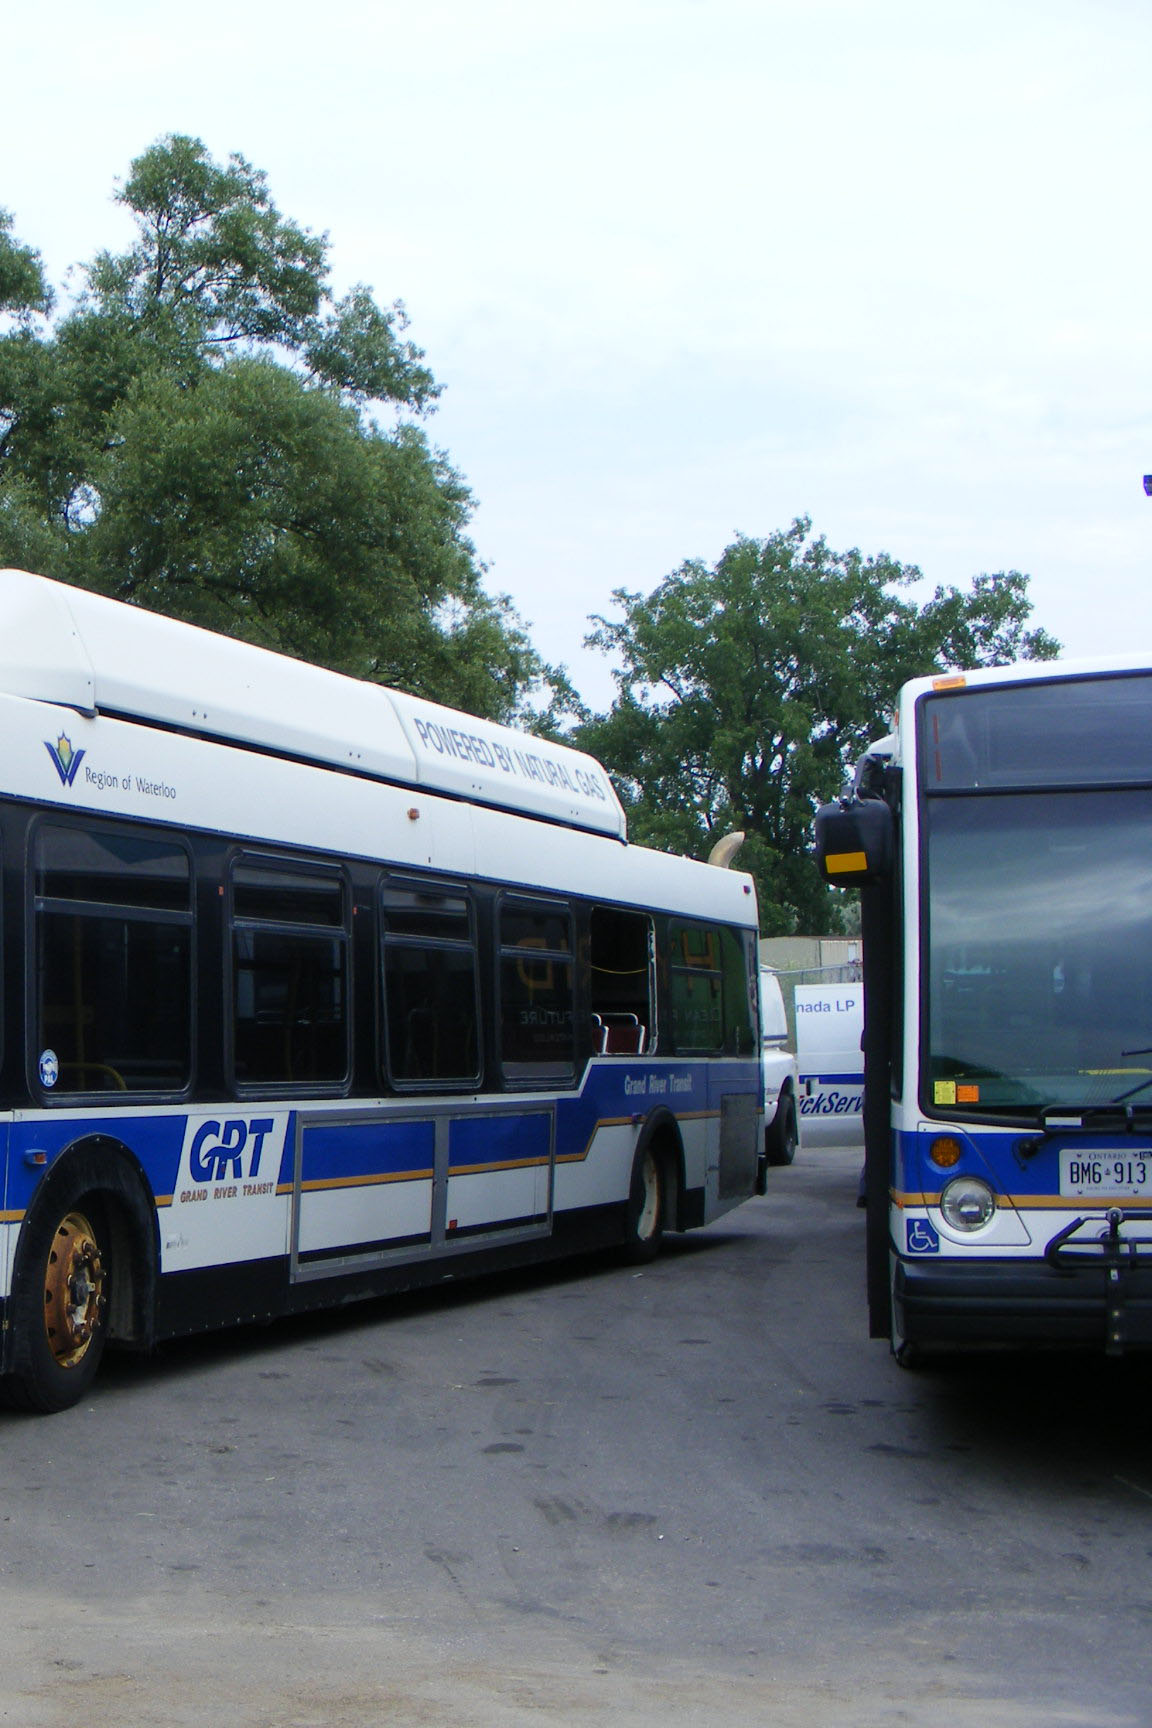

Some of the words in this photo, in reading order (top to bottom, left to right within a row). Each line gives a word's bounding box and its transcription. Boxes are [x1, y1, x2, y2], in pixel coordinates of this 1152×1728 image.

[414, 718, 496, 768] POWERED
[492, 742, 517, 775] BY
[514, 750, 580, 793] NATURAL
[575, 769, 606, 801] GAS
[85, 767, 119, 790] Region
[122, 776, 134, 790] of
[135, 777, 176, 800] Waterloo
[796, 1001, 831, 1013] nada
[836, 1000, 855, 1012] LP
[624, 1074, 646, 1096] Grand
[189, 1118, 274, 1183] GRT
[1070, 1161, 1101, 1184] BM6
[1114, 1161, 1146, 1184] 913
[180, 1189, 208, 1203] GRAND
[214, 1185, 237, 1200] RIVER
[243, 1182, 274, 1196] TRANSIT
